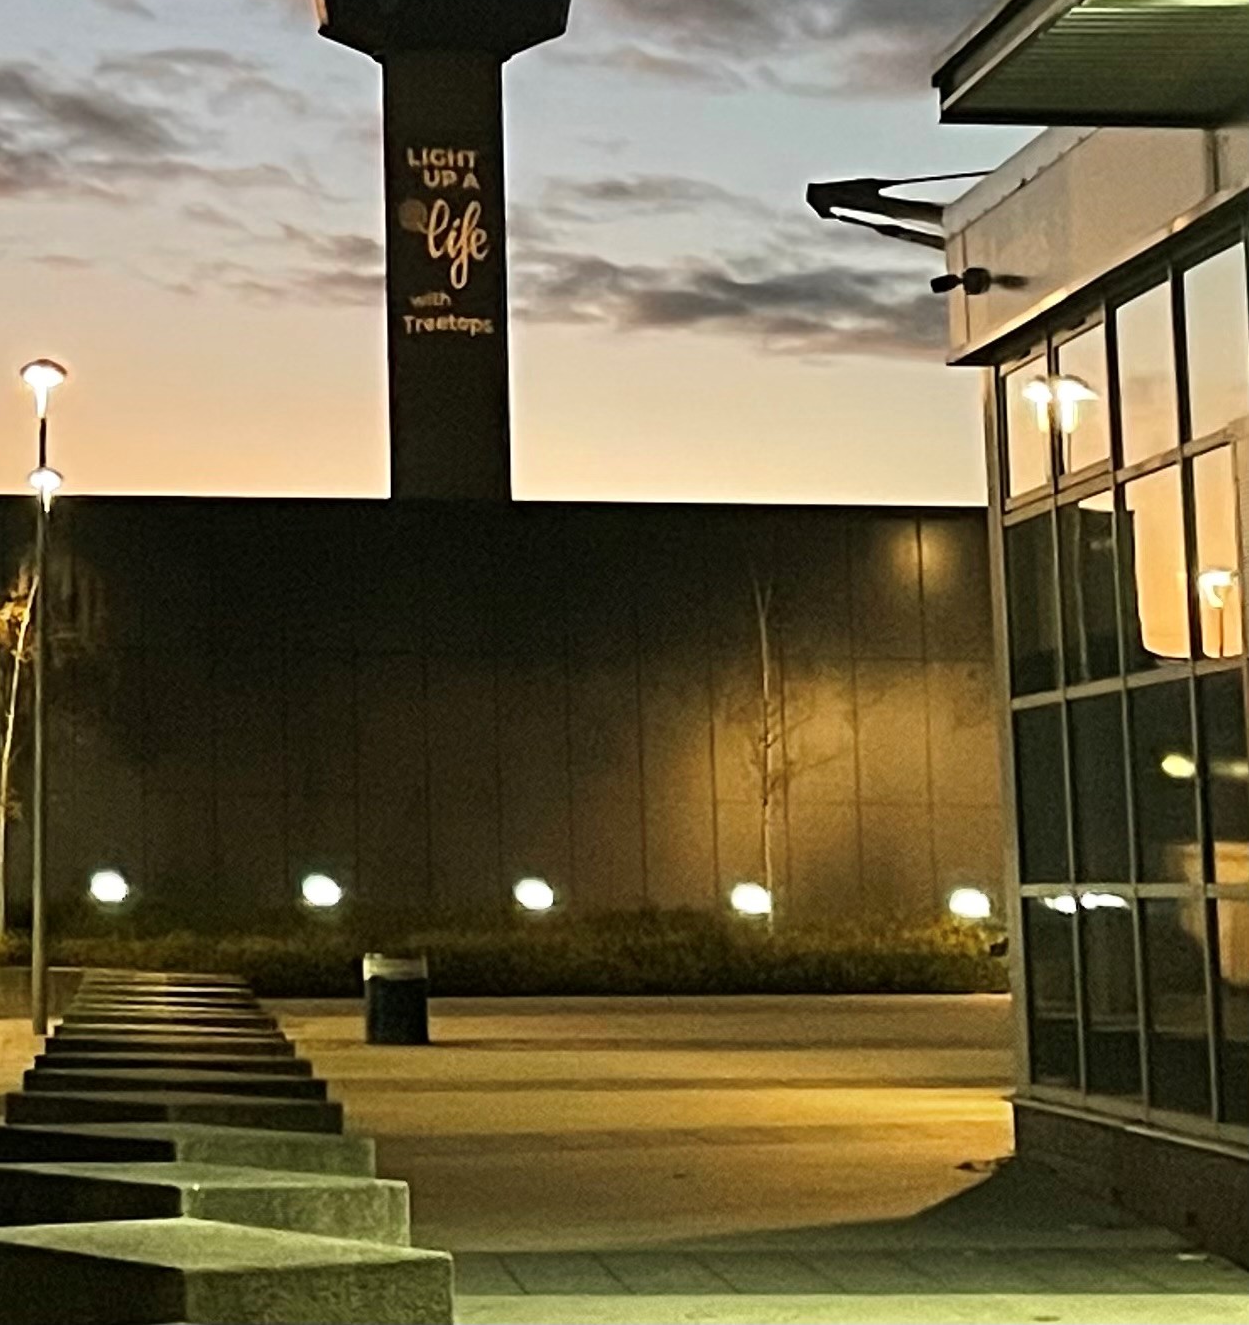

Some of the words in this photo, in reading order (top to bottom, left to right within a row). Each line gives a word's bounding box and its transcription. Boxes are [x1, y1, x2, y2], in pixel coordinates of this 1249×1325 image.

[407, 147, 476, 168] LIGHT
[423, 170, 457, 187] UP
[462, 173, 480, 189] A
[426, 198, 489, 289] life
[402, 313, 496, 338] Treetops
